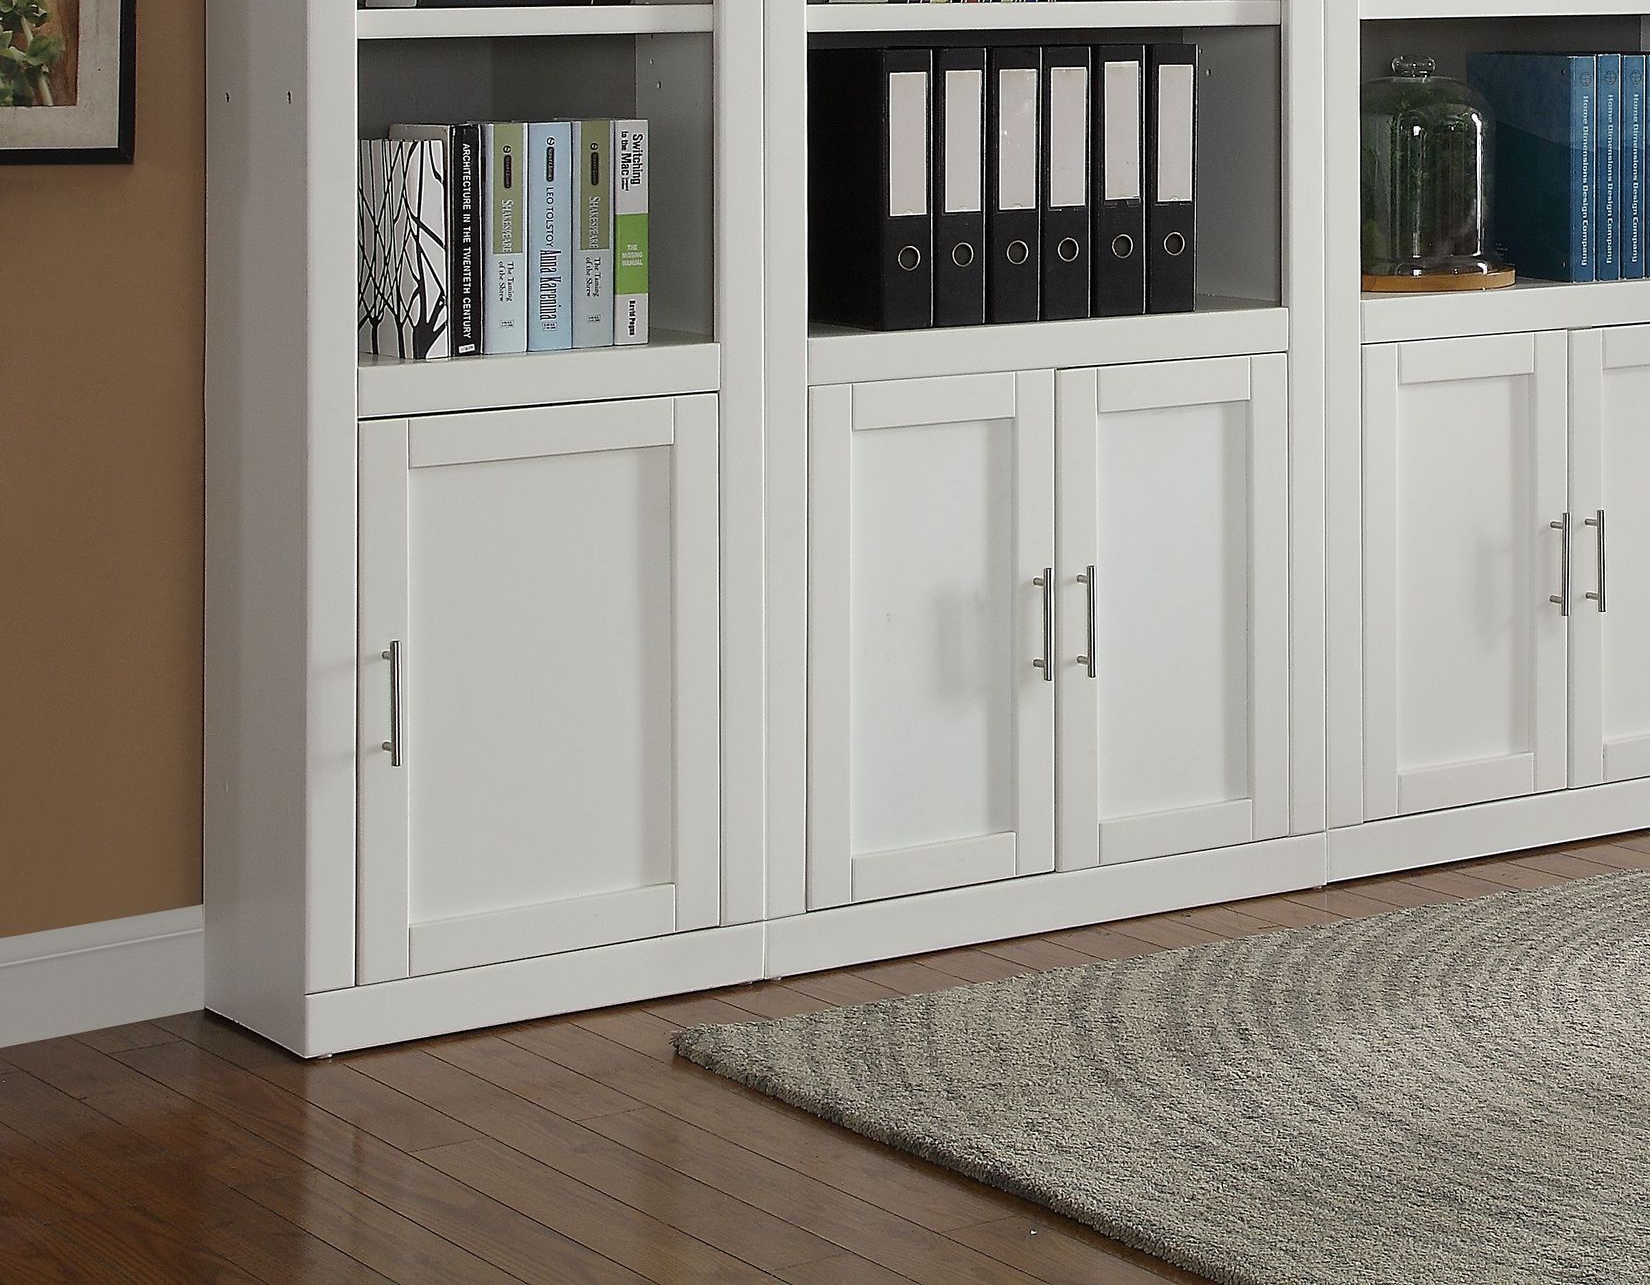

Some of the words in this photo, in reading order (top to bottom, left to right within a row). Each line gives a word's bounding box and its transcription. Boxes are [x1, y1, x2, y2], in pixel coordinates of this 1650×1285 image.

[1581, 95, 1589, 124] Home
[1606, 94, 1614, 122] Home
[621, 153, 632, 175] Mac
[630, 134, 644, 184] Switching
[1581, 126, 1589, 184] Dimensions
[1606, 125, 1614, 182] Dimensions
[462, 143, 471, 210] ARCHITECTURE
[546, 187, 554, 204] LEO
[1581, 185, 1589, 218] Design
[1606, 183, 1614, 216] Design
[462, 214, 471, 222] IN
[462, 226, 471, 243] THE
[546, 207, 554, 248] TOLSTOY
[1581, 219, 1589, 266] Company
[1606, 218, 1614, 264] Company
[540, 249, 561, 273] Anna
[540, 276, 561, 321] Karenina
[462, 297, 471, 339] CENTURY
